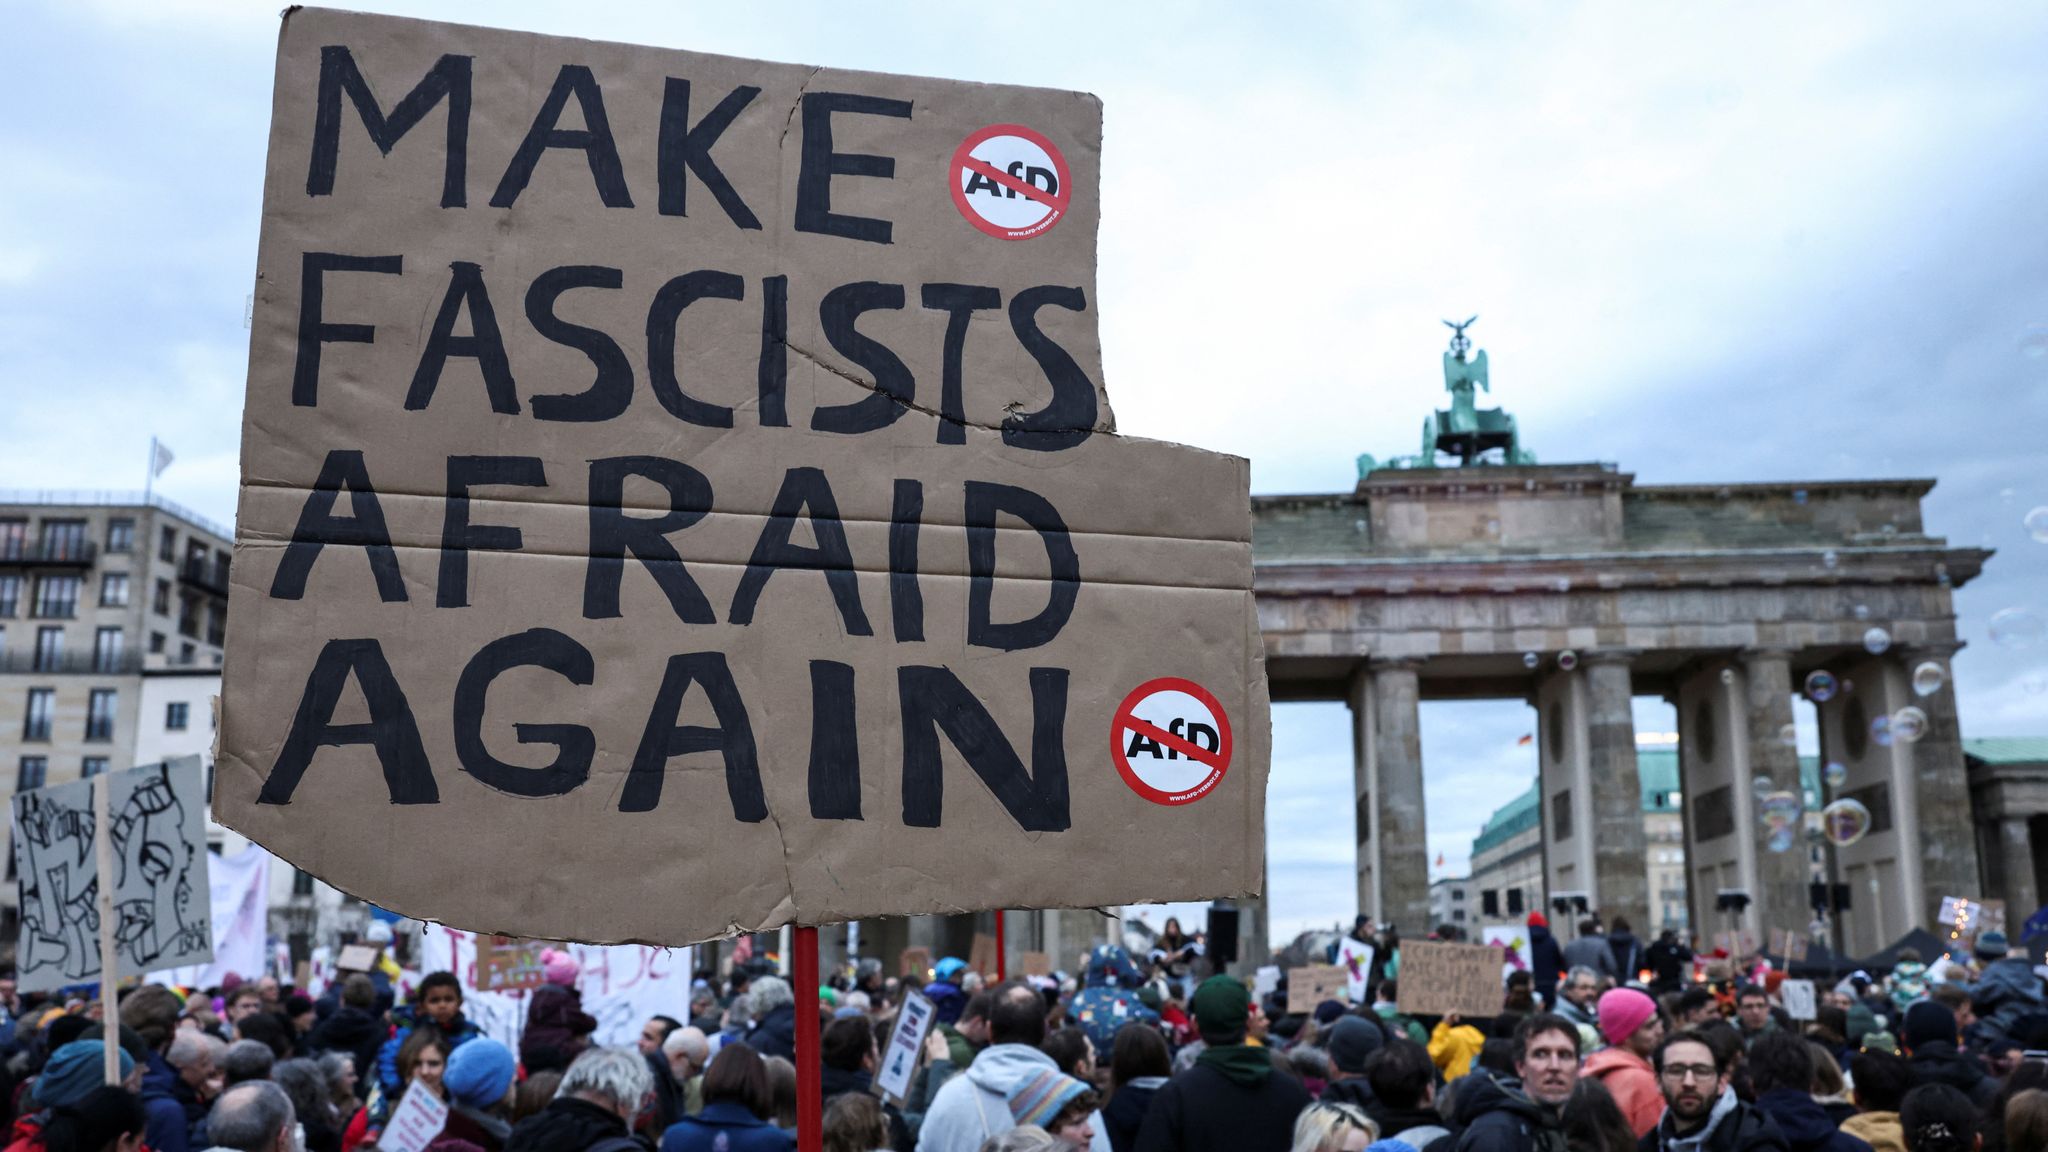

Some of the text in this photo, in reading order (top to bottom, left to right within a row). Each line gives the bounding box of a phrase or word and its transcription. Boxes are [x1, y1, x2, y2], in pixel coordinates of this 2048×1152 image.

[305, 45, 915, 244] MAKE
[964, 161, 1058, 201] AfD
[291, 252, 1098, 452] FASCISTS
[269, 450, 1081, 650] AFRAID
[256, 627, 1070, 832] AGAIN
[1126, 717, 1219, 761] AfD
[1168, 769, 1221, 801] WWW.AFD-VERBOT.DE
